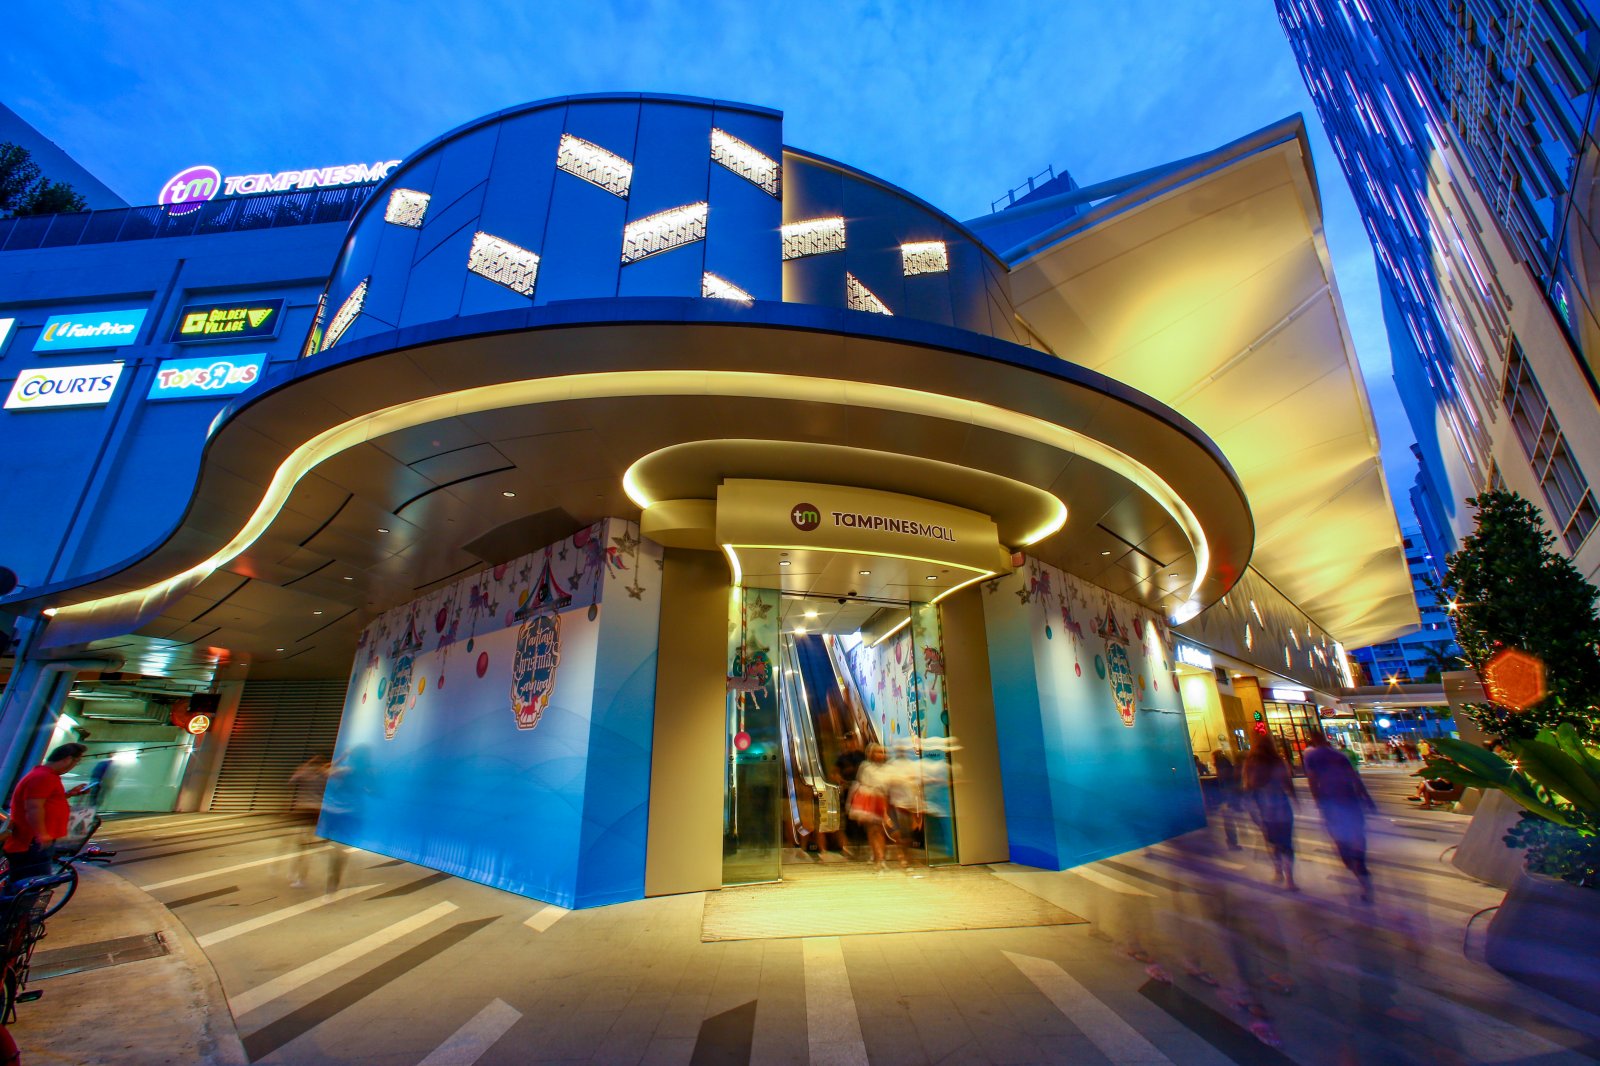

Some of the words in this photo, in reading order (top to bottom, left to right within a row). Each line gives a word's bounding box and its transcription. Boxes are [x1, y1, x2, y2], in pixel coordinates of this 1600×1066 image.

[209, 308, 248, 322] GOLDEN
[66, 321, 135, 338] FairPrice
[204, 320, 245, 334] VILLAGE
[23, 375, 114, 396] COURTS
